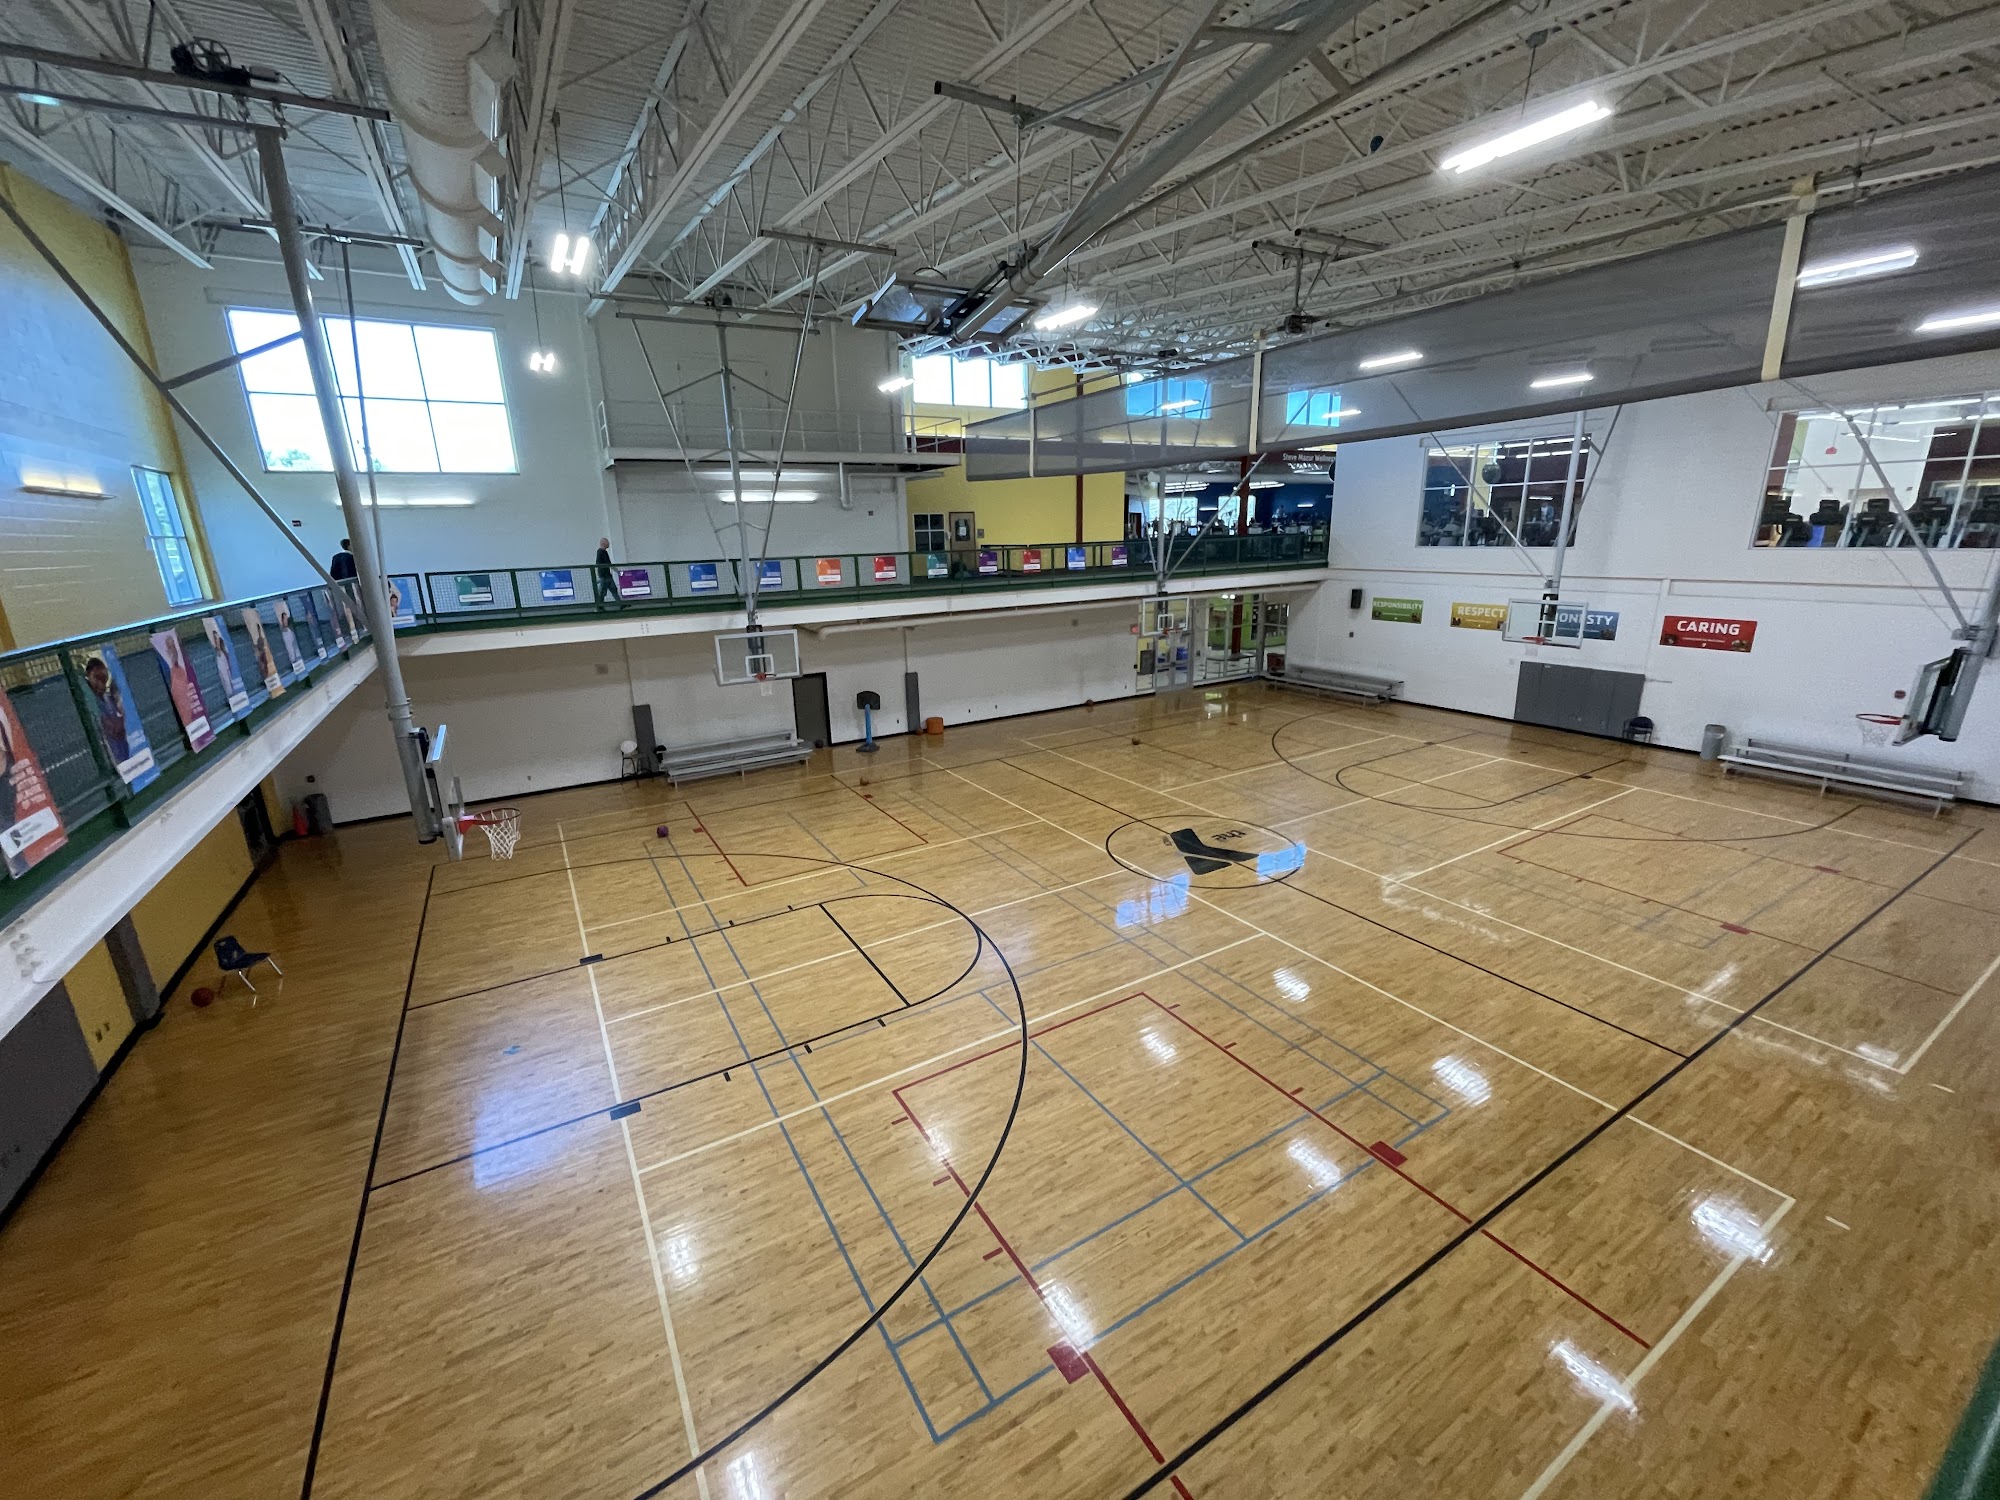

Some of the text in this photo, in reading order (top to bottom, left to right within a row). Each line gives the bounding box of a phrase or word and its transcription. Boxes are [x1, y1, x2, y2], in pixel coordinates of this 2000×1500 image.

[1282, 453, 1297, 461] Steve
[1373, 600, 1423, 610] RESPONSIBILITY
[1457, 606, 1506, 618] RESPECT
[1556, 612, 1614, 626] ONSTY
[1677, 620, 1741, 636] CARING
[1211, 829, 1247, 841] the
